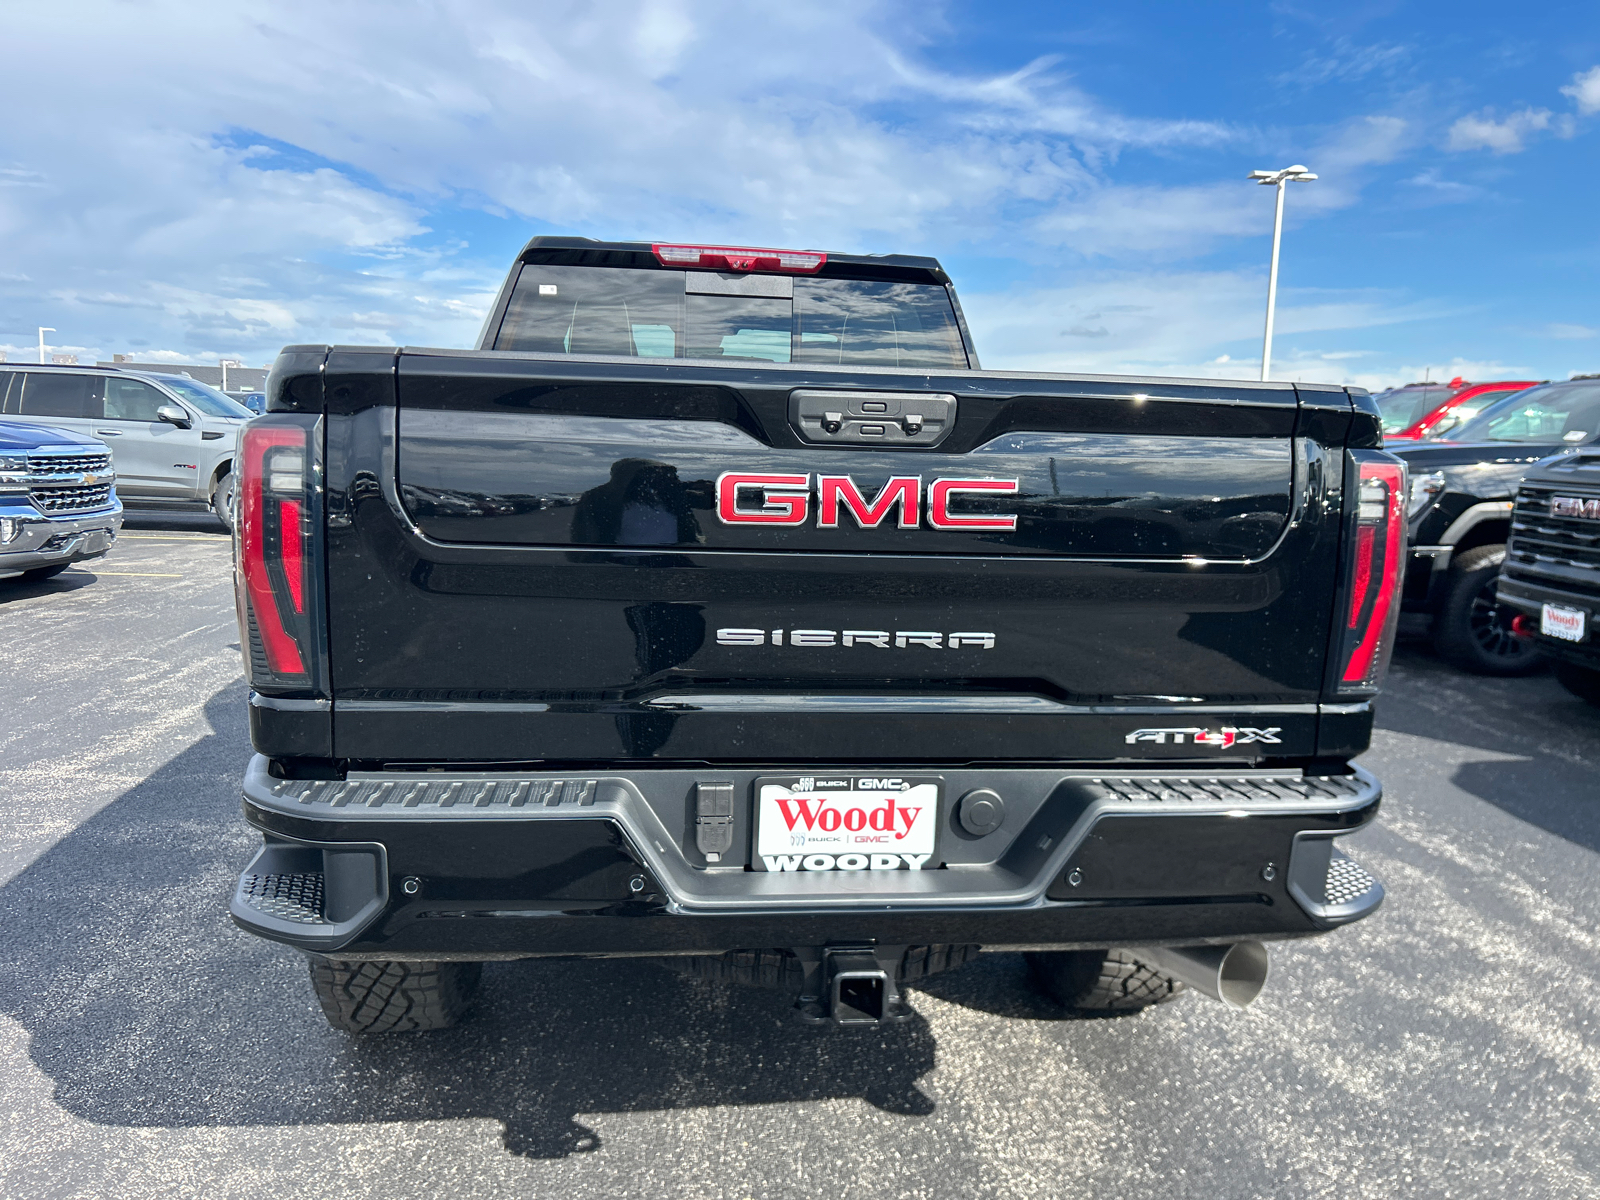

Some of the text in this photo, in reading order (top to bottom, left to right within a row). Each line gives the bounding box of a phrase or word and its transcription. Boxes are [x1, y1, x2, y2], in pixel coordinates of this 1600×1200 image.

[715, 471, 1019, 532] GMC
[1551, 496, 1600, 519] GM
[1547, 609, 1580, 630] Woody
[716, 628, 996, 650] SIERRA
[1125, 726, 1283, 749] AT4X
[858, 778, 903, 790] GMC
[775, 799, 923, 840] Woody
[854, 835, 889, 843] GMC
[762, 853, 932, 872] WOODY
